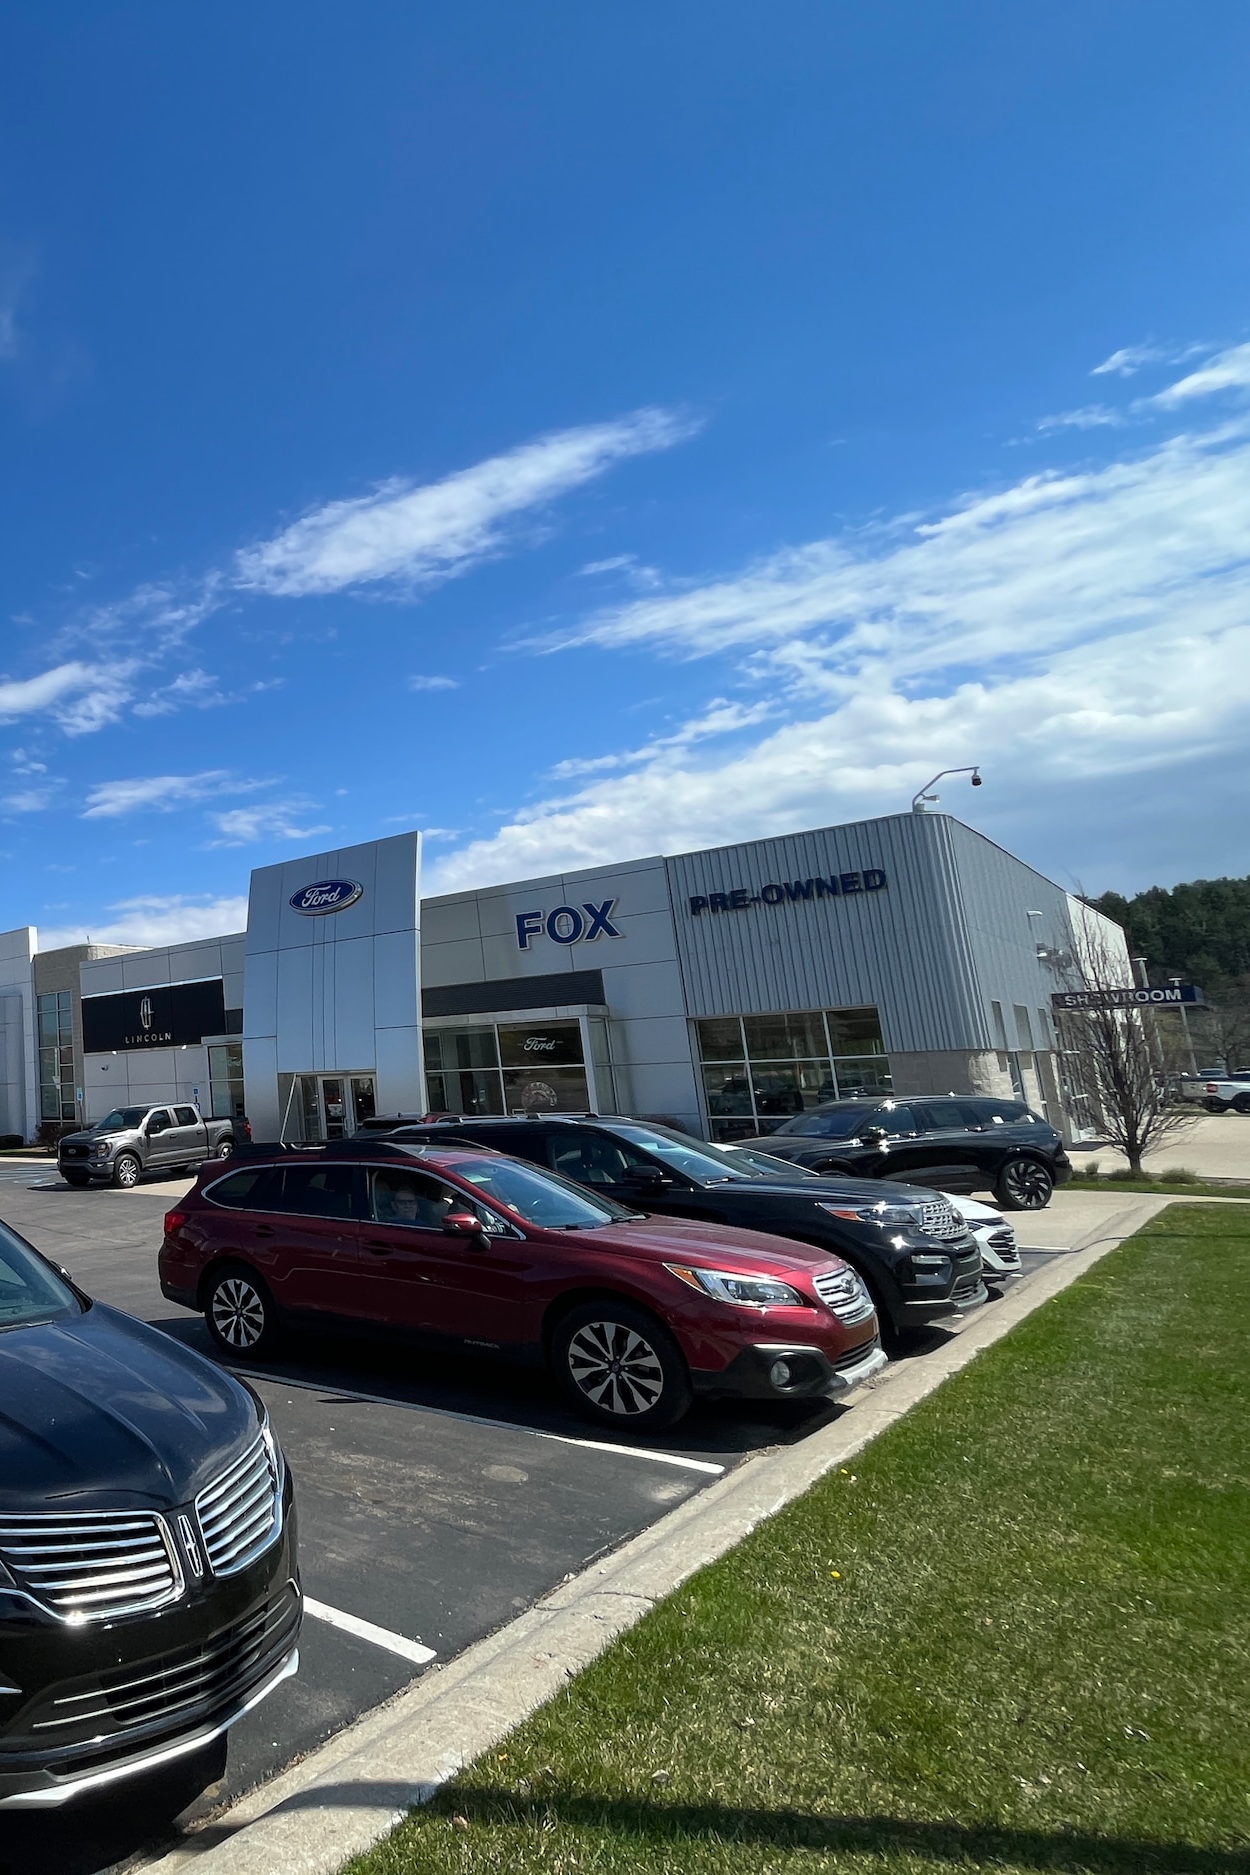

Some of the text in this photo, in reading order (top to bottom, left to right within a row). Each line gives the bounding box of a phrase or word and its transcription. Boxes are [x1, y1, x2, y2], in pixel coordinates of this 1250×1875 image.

[301, 885, 341, 908] Ford
[689, 868, 887, 915] PRE-OWNED
[514, 898, 624, 951] FOX
[125, 1032, 172, 1044] LINCOLN
[523, 1036, 556, 1051] Ford
